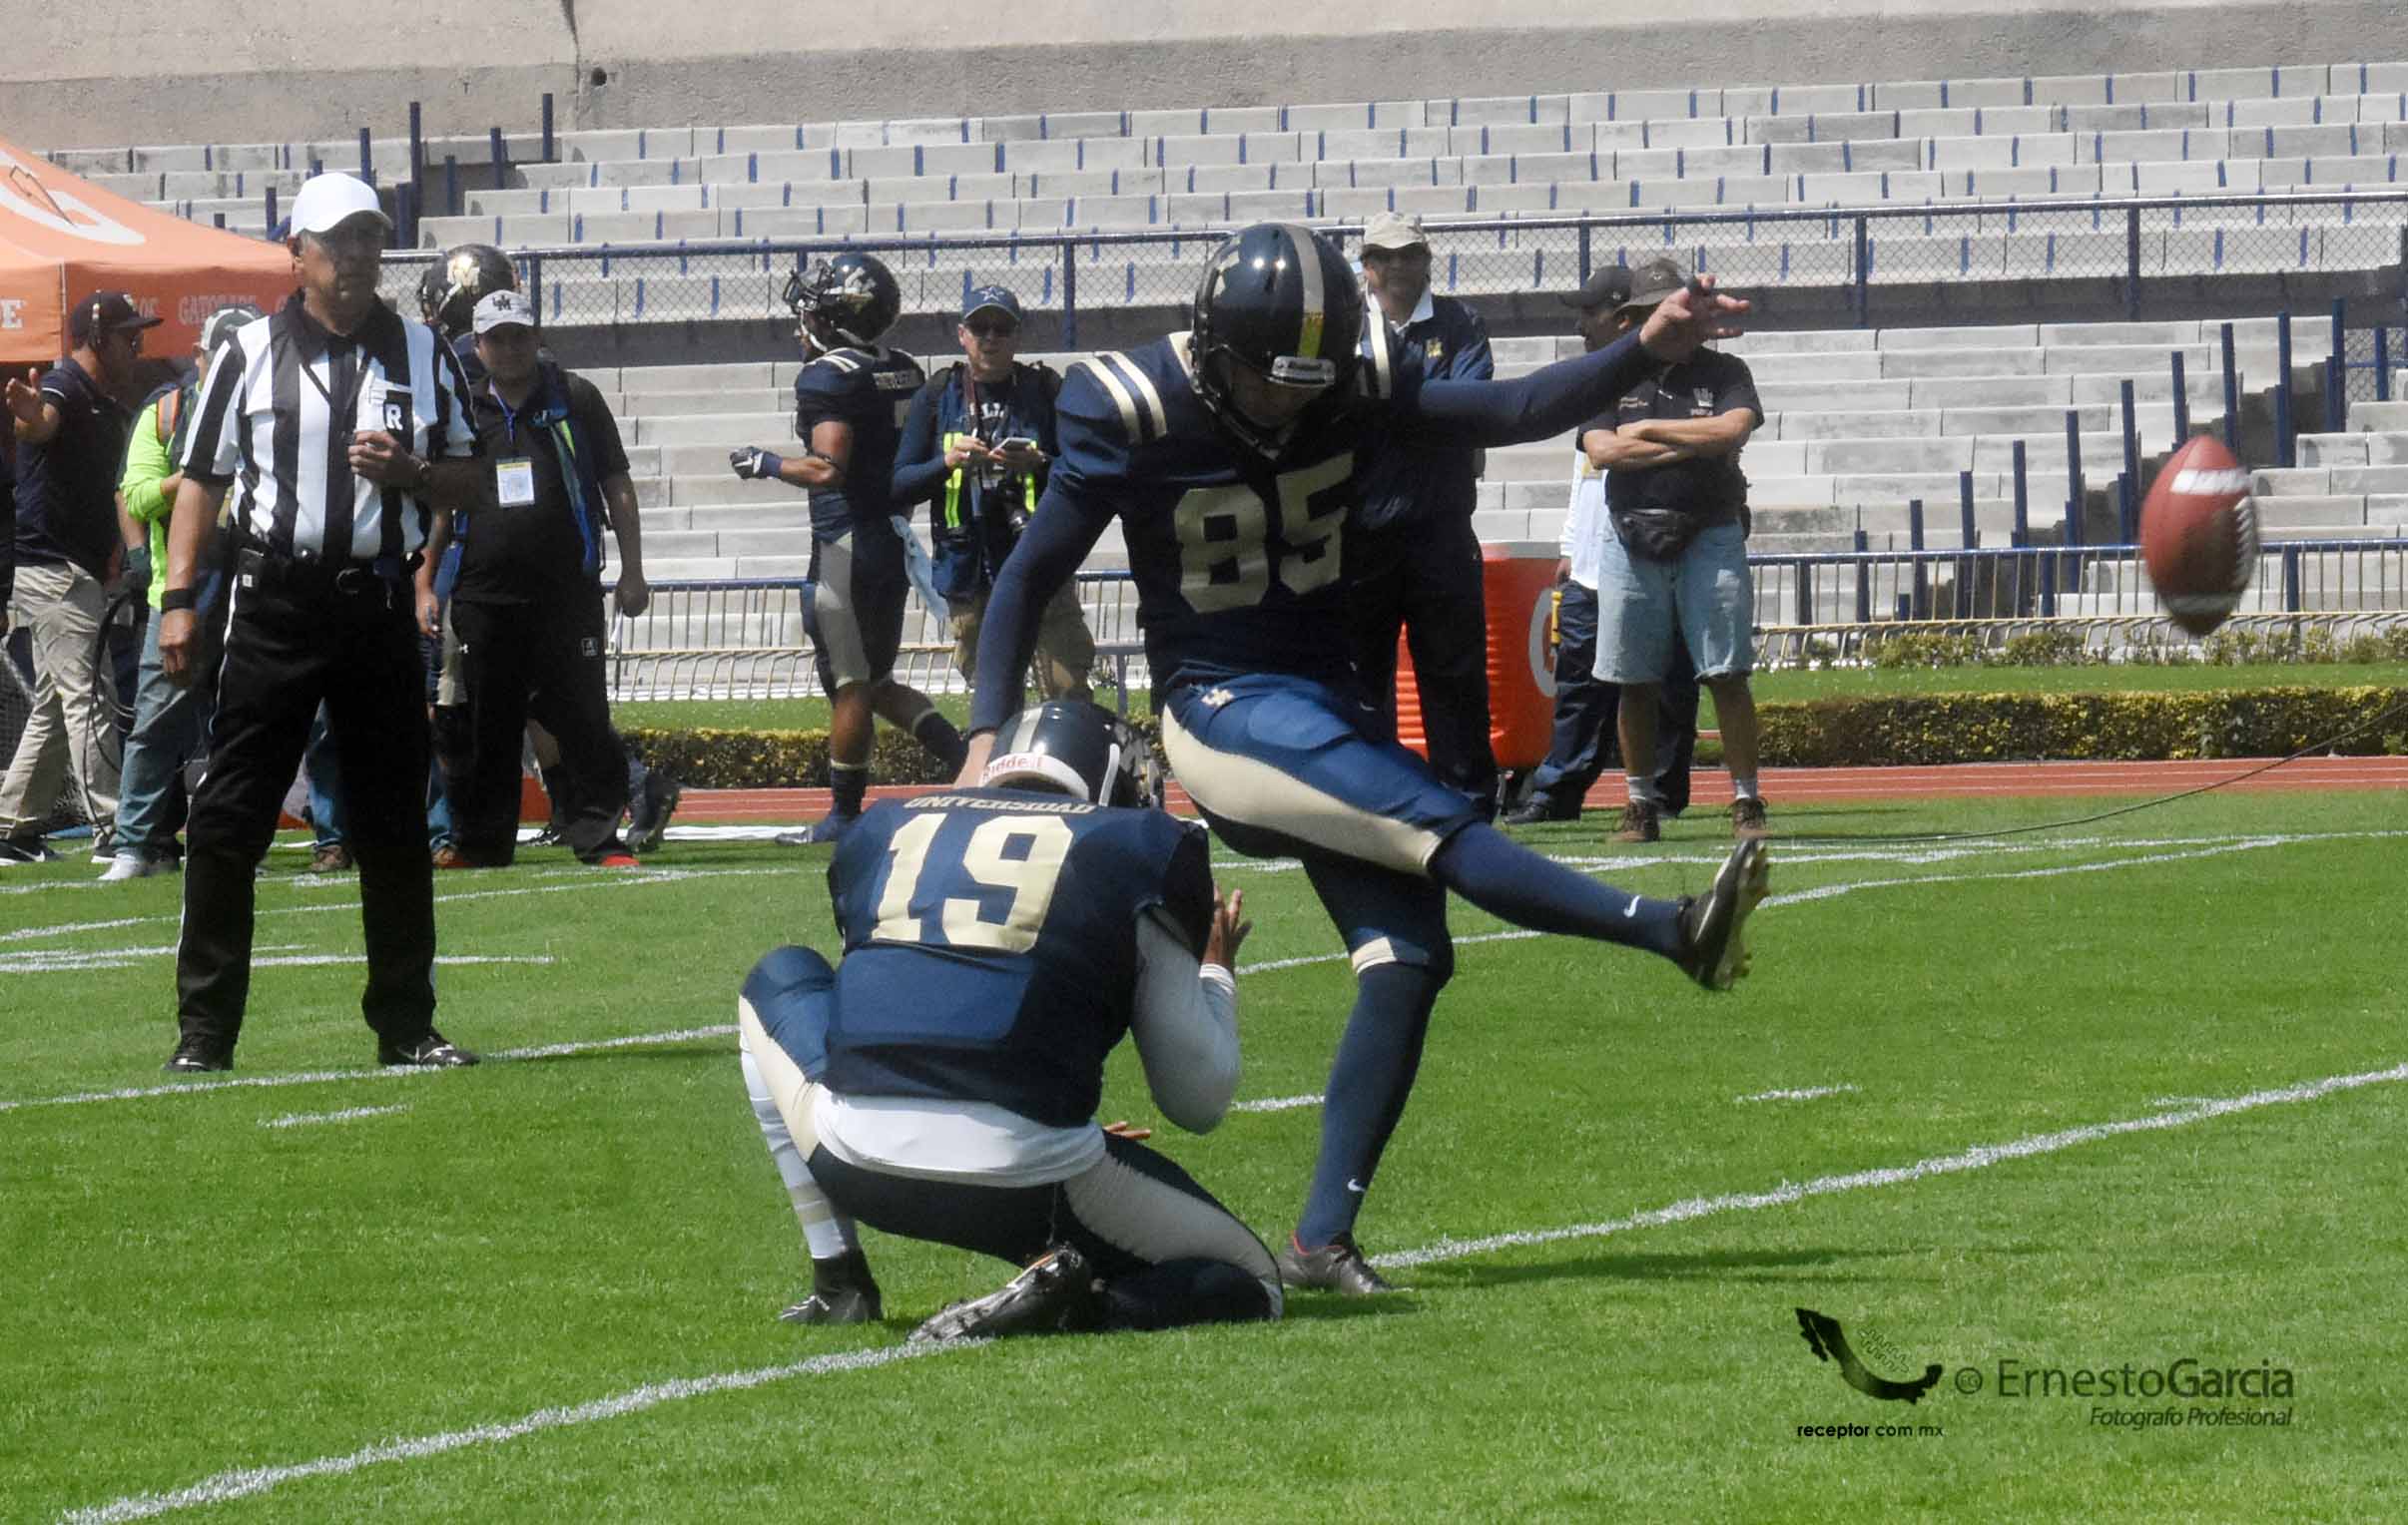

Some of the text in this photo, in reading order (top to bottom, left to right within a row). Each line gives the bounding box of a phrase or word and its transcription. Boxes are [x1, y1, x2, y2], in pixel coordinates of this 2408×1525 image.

[386, 403, 402, 430] R
[1174, 451, 1355, 614] 85
[872, 812, 1074, 955] 19
